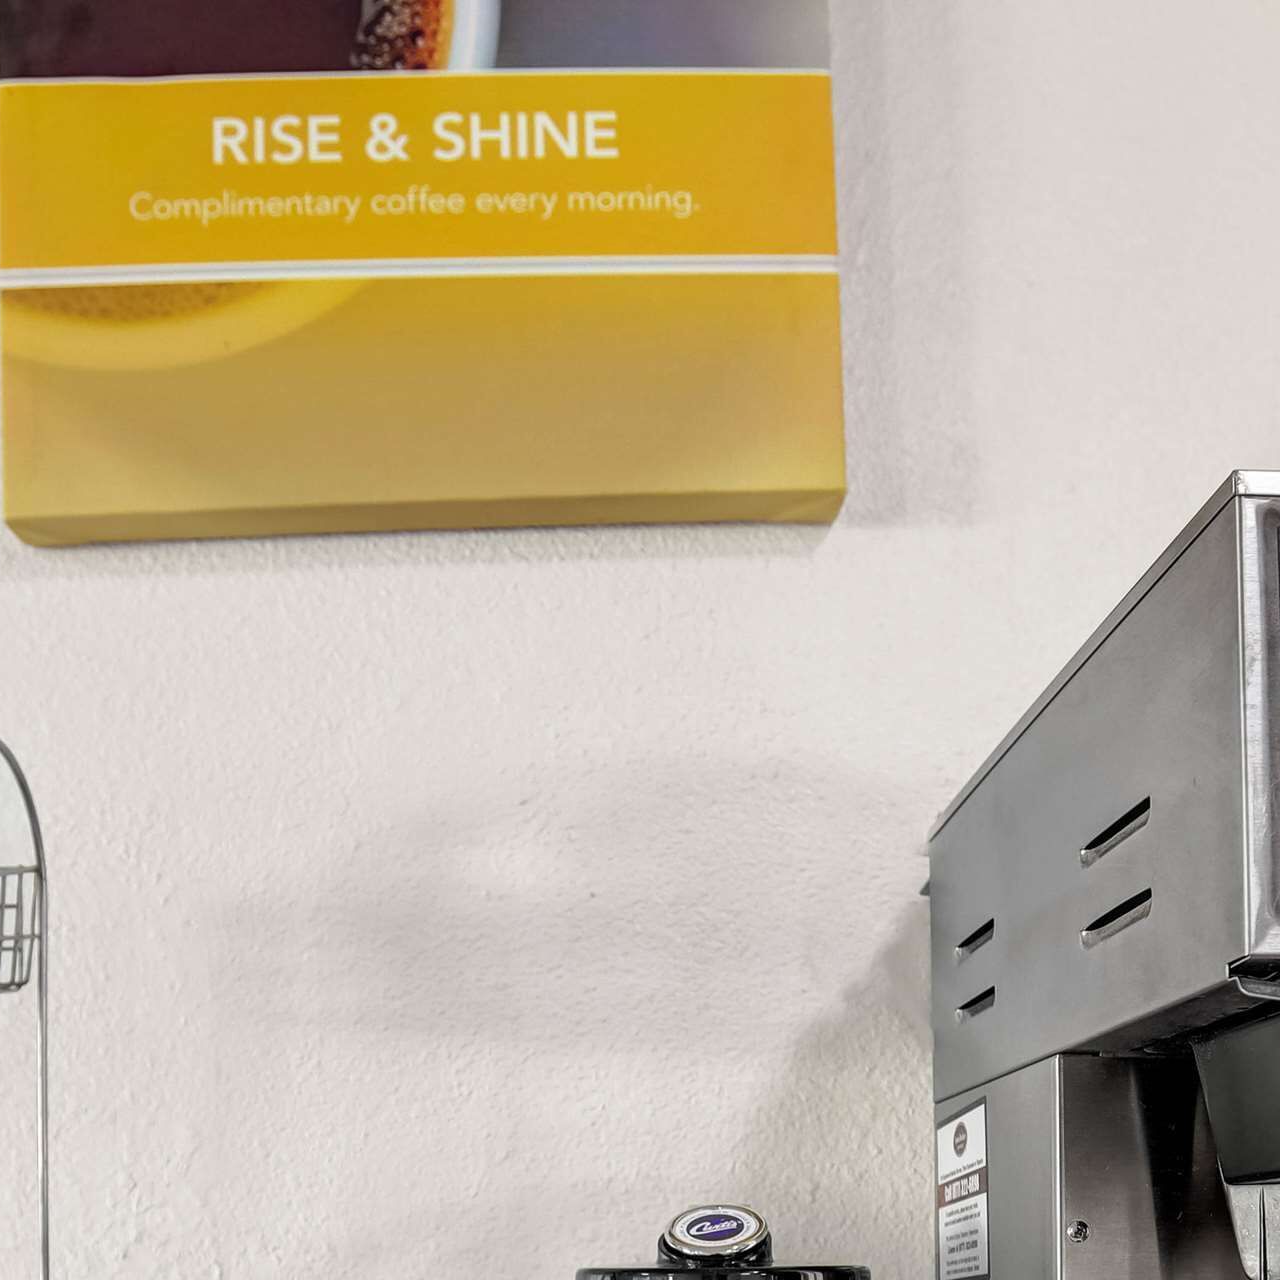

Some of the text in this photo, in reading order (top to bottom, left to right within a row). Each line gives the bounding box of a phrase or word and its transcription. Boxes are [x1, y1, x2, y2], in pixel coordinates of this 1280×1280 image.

[212, 111, 619, 165] RISE & SHINE
[129, 184, 700, 226] Complimentary coffee every morning.
